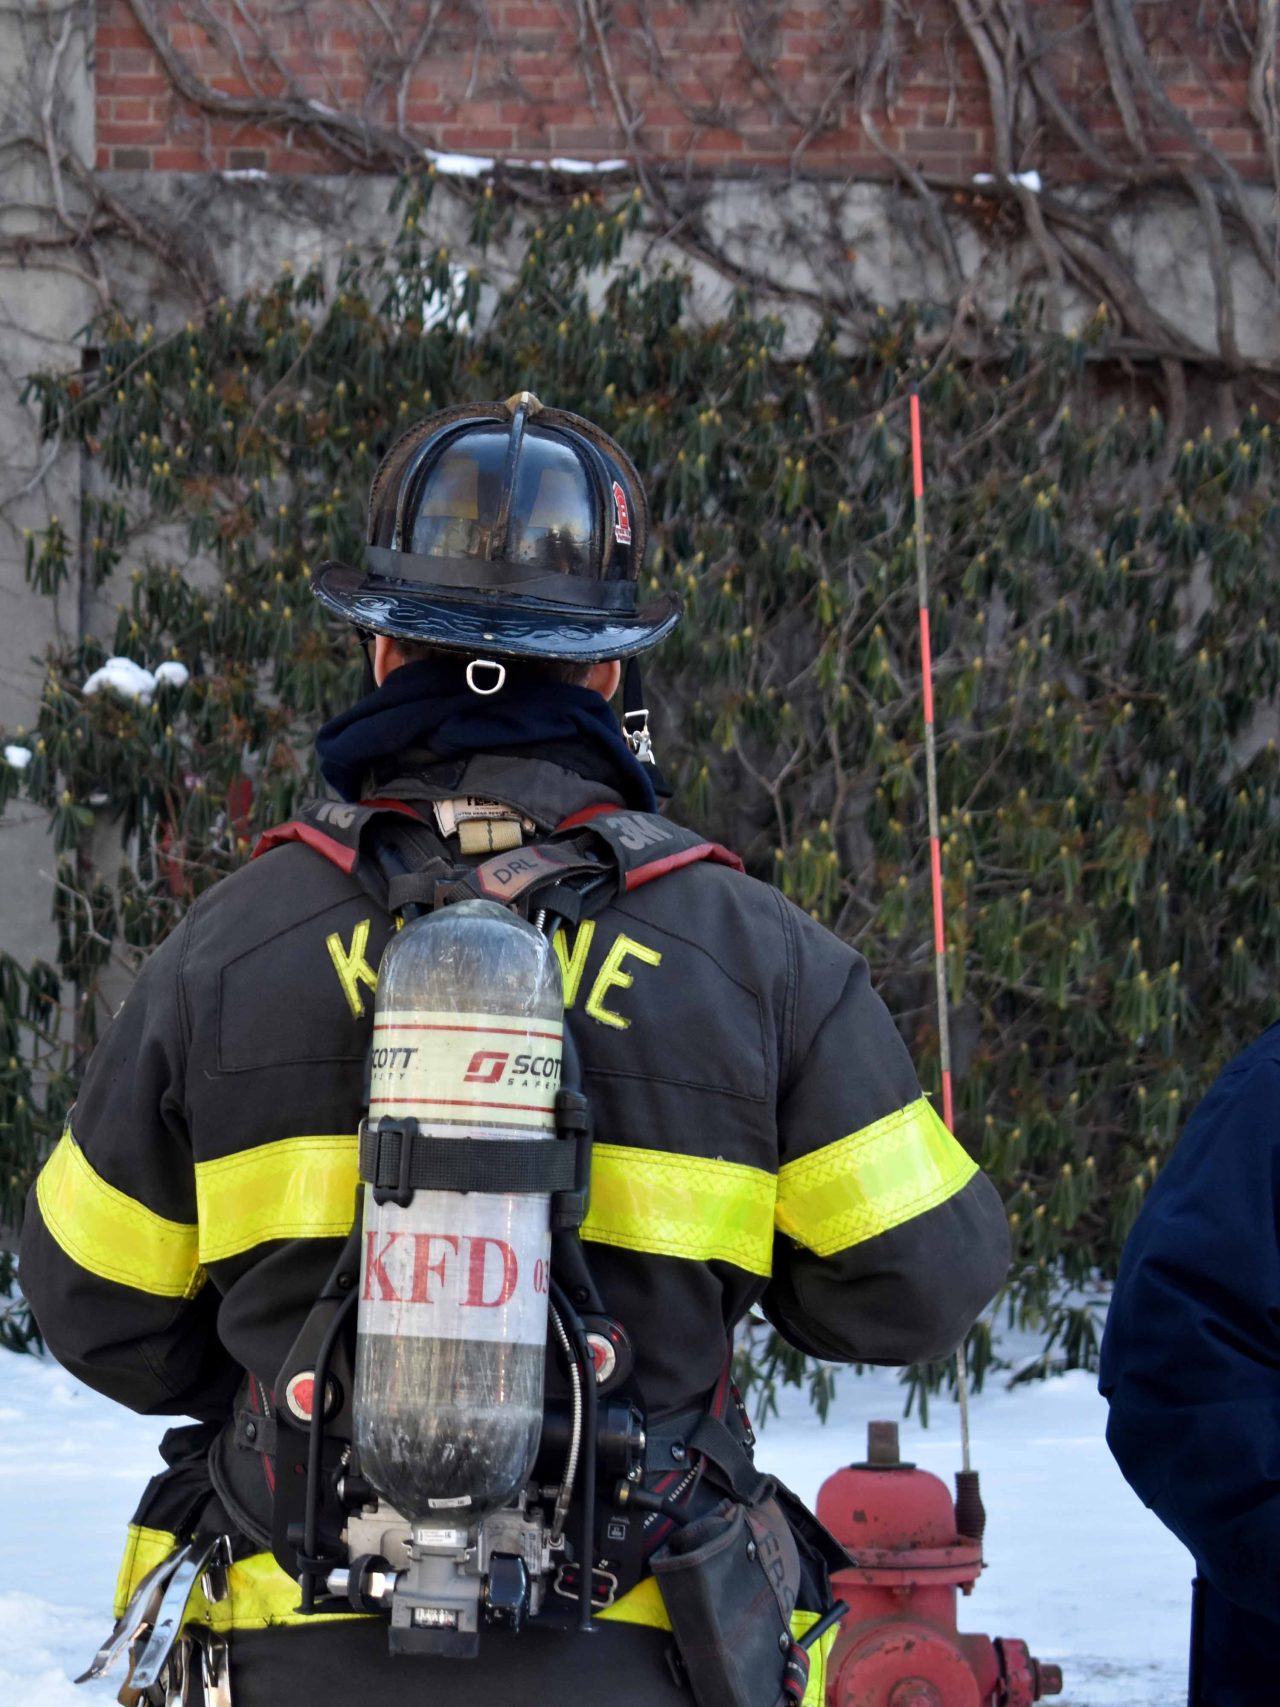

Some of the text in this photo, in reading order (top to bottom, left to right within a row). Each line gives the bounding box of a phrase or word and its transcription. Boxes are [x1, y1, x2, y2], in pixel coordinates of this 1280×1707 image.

[492, 858, 538, 885] DRL
[372, 1047, 419, 1069] COTT
[511, 1054, 561, 1079] SCOT
[506, 1077, 560, 1090] SAFET
[361, 1230, 518, 1309] KFD
